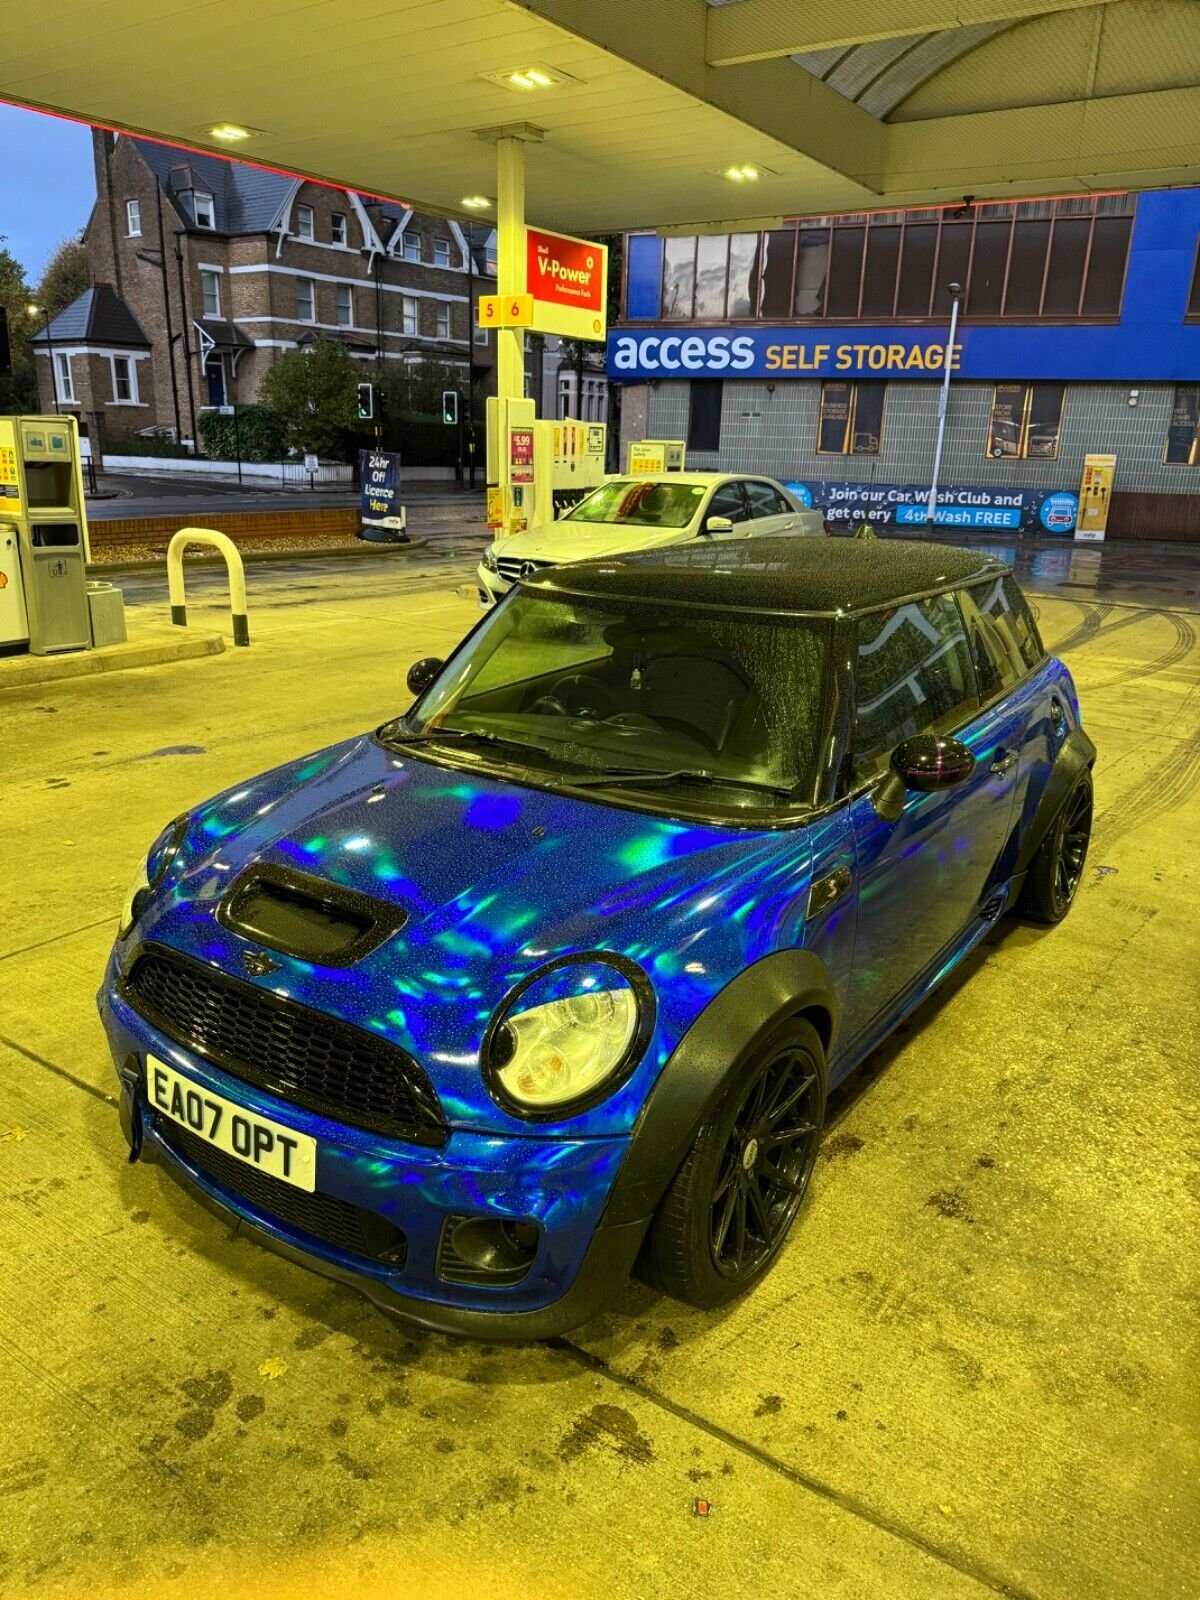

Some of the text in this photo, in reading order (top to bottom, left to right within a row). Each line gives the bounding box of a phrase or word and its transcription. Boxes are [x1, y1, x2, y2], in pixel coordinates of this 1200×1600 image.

[538, 255, 591, 285] V-Power
[486, 303, 494, 317] 5
[511, 301, 520, 317] 6
[614, 336, 963, 370] access SELF STORAGE
[368, 456, 389, 468] 24hr
[372, 471, 386, 482] Off
[365, 484, 394, 499] Licence
[829, 487, 1023, 506] Join our Car Wsh Club and
[369, 499, 389, 512] Here
[826, 507, 850, 521] get
[904, 509, 928, 522] 4th
[932, 510, 971, 523] Wash
[974, 511, 1012, 525] FREE
[154, 1067, 298, 1178] EA07 OPT
